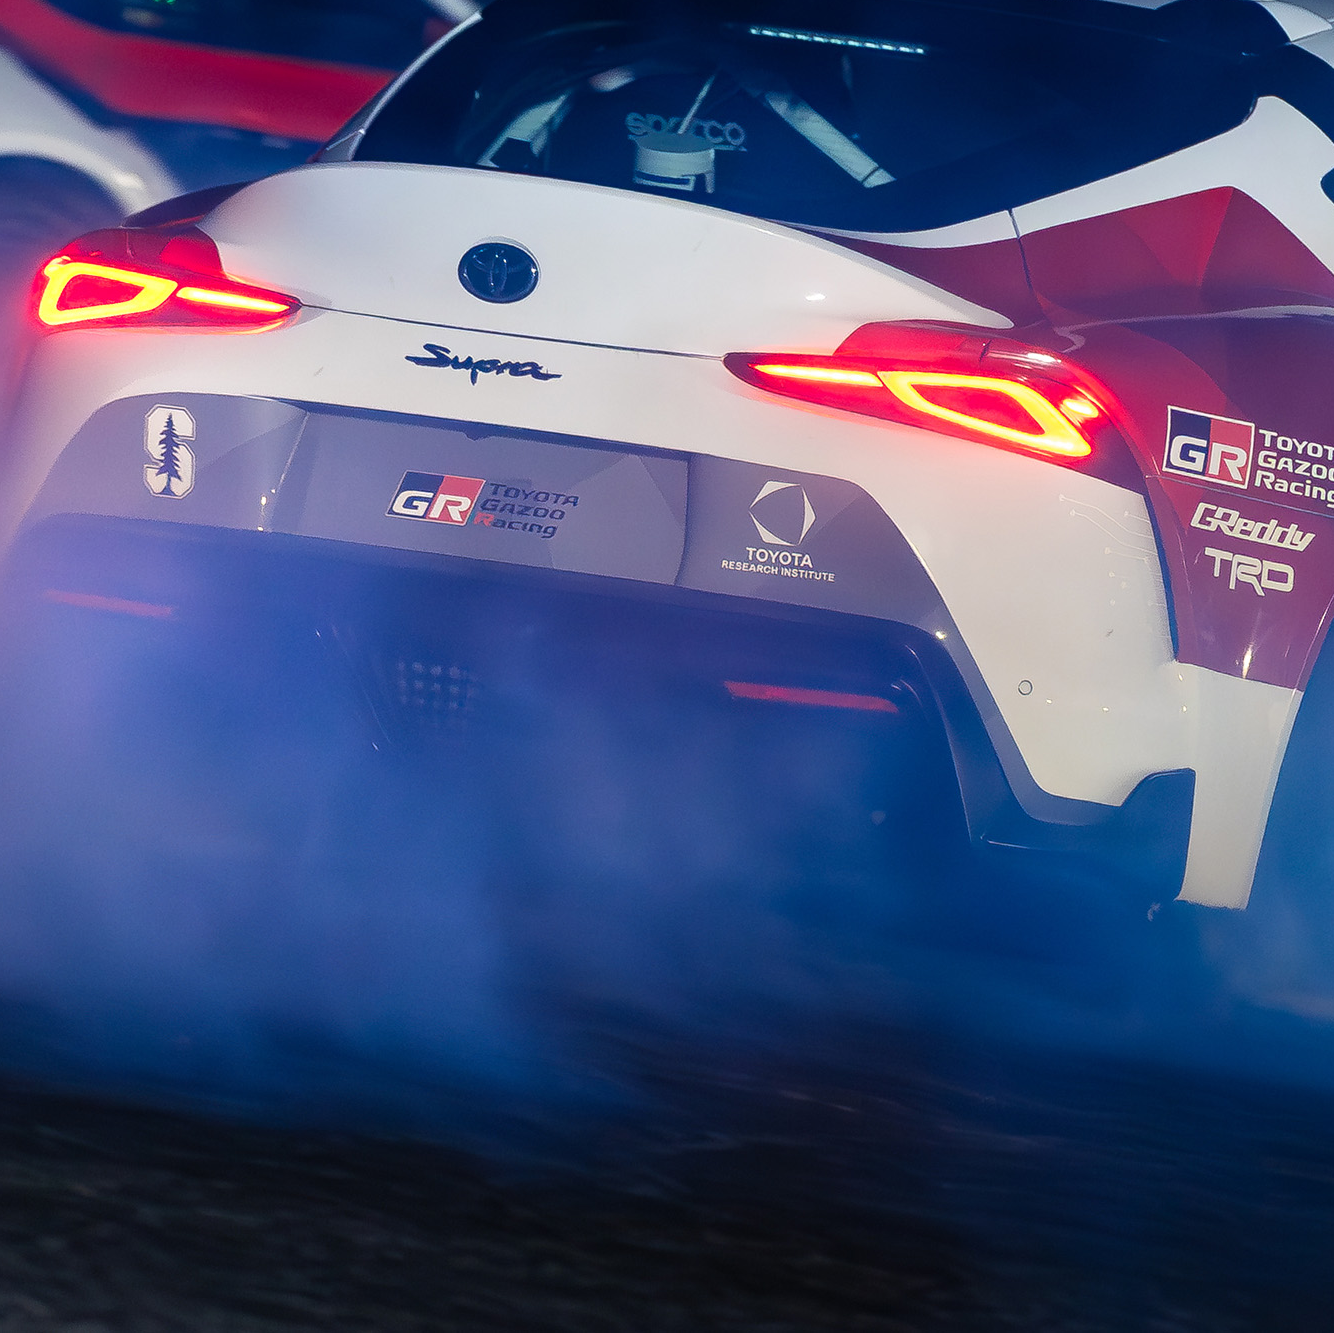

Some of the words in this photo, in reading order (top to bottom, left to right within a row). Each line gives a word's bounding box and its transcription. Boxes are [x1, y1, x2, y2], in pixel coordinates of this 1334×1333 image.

[405, 343, 562, 386] Supra
[1169, 434, 1248, 481] GR
[392, 490, 472, 524] GR
[480, 498, 566, 520] GAZOO
[490, 482, 580, 507] TOYOTA
[473, 512, 558, 539] Racing
[1190, 502, 1316, 552] GReddy
[721, 559, 779, 576] RESEARCH
[780, 567, 836, 583] INSTITUTE
[746, 546, 814, 569] TOYOTA
[1204, 546, 1296, 597] TRD
